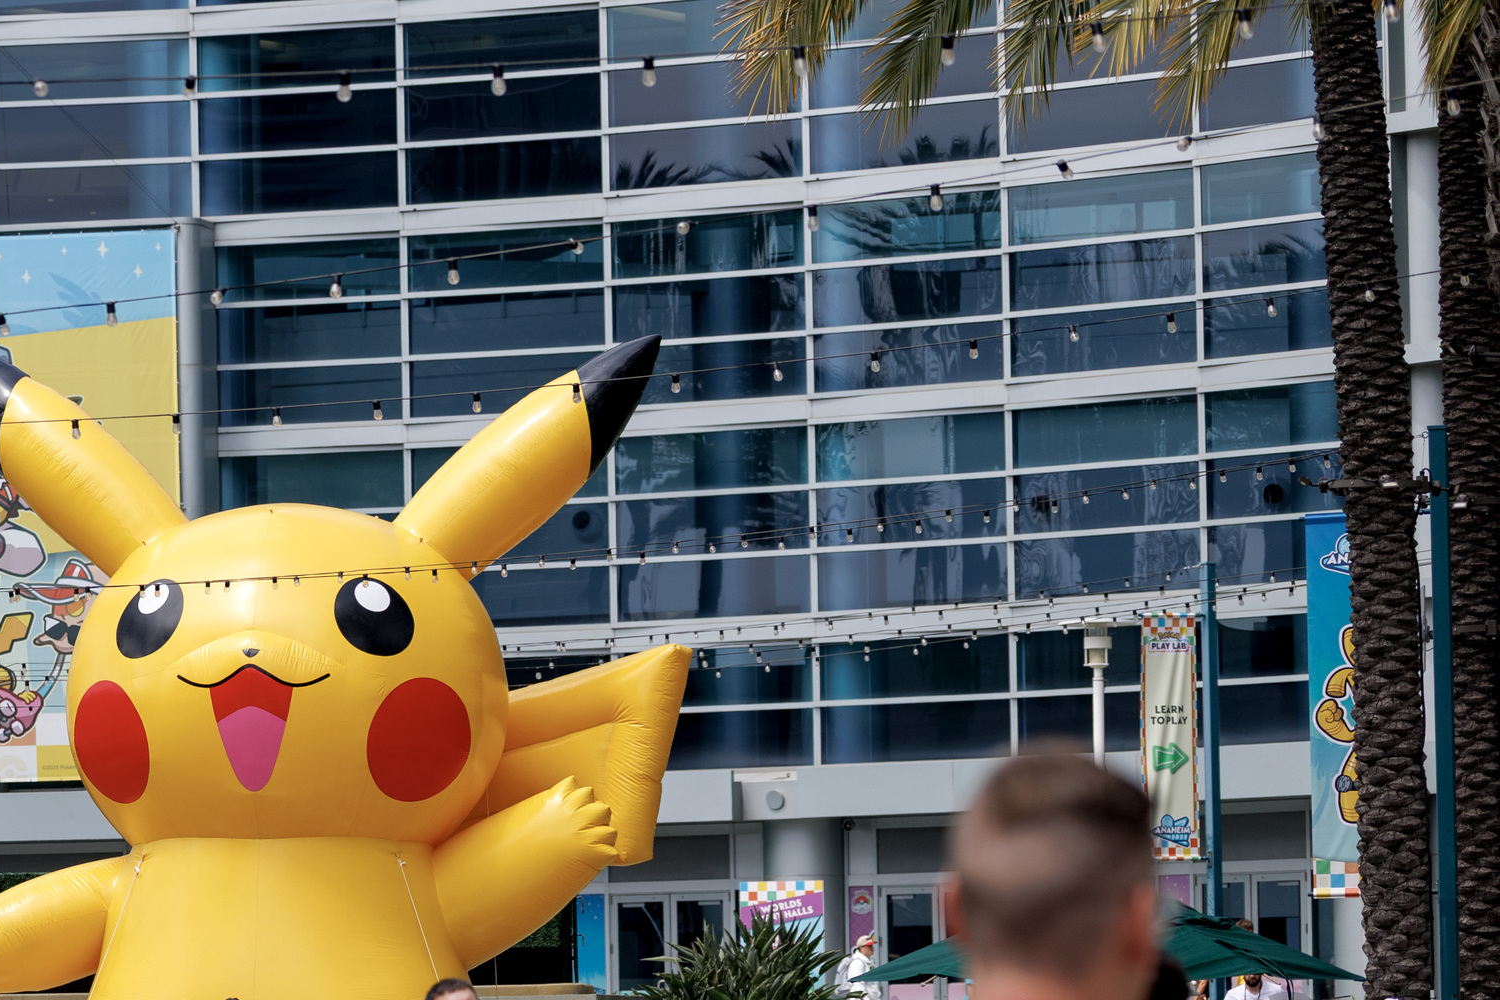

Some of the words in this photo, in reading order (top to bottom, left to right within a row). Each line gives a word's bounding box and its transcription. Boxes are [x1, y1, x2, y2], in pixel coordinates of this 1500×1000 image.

[1327, 553, 1352, 564] AN
[1151, 642, 1170, 650] PLAY
[1155, 705, 1184, 713] LEARN
[1150, 716, 1165, 724] TO
[1165, 716, 1188, 724] PLAY
[1155, 826, 1191, 834] ANAHEIM
[760, 898, 802, 913] WORLDS
[784, 905, 814, 919] HALLS
